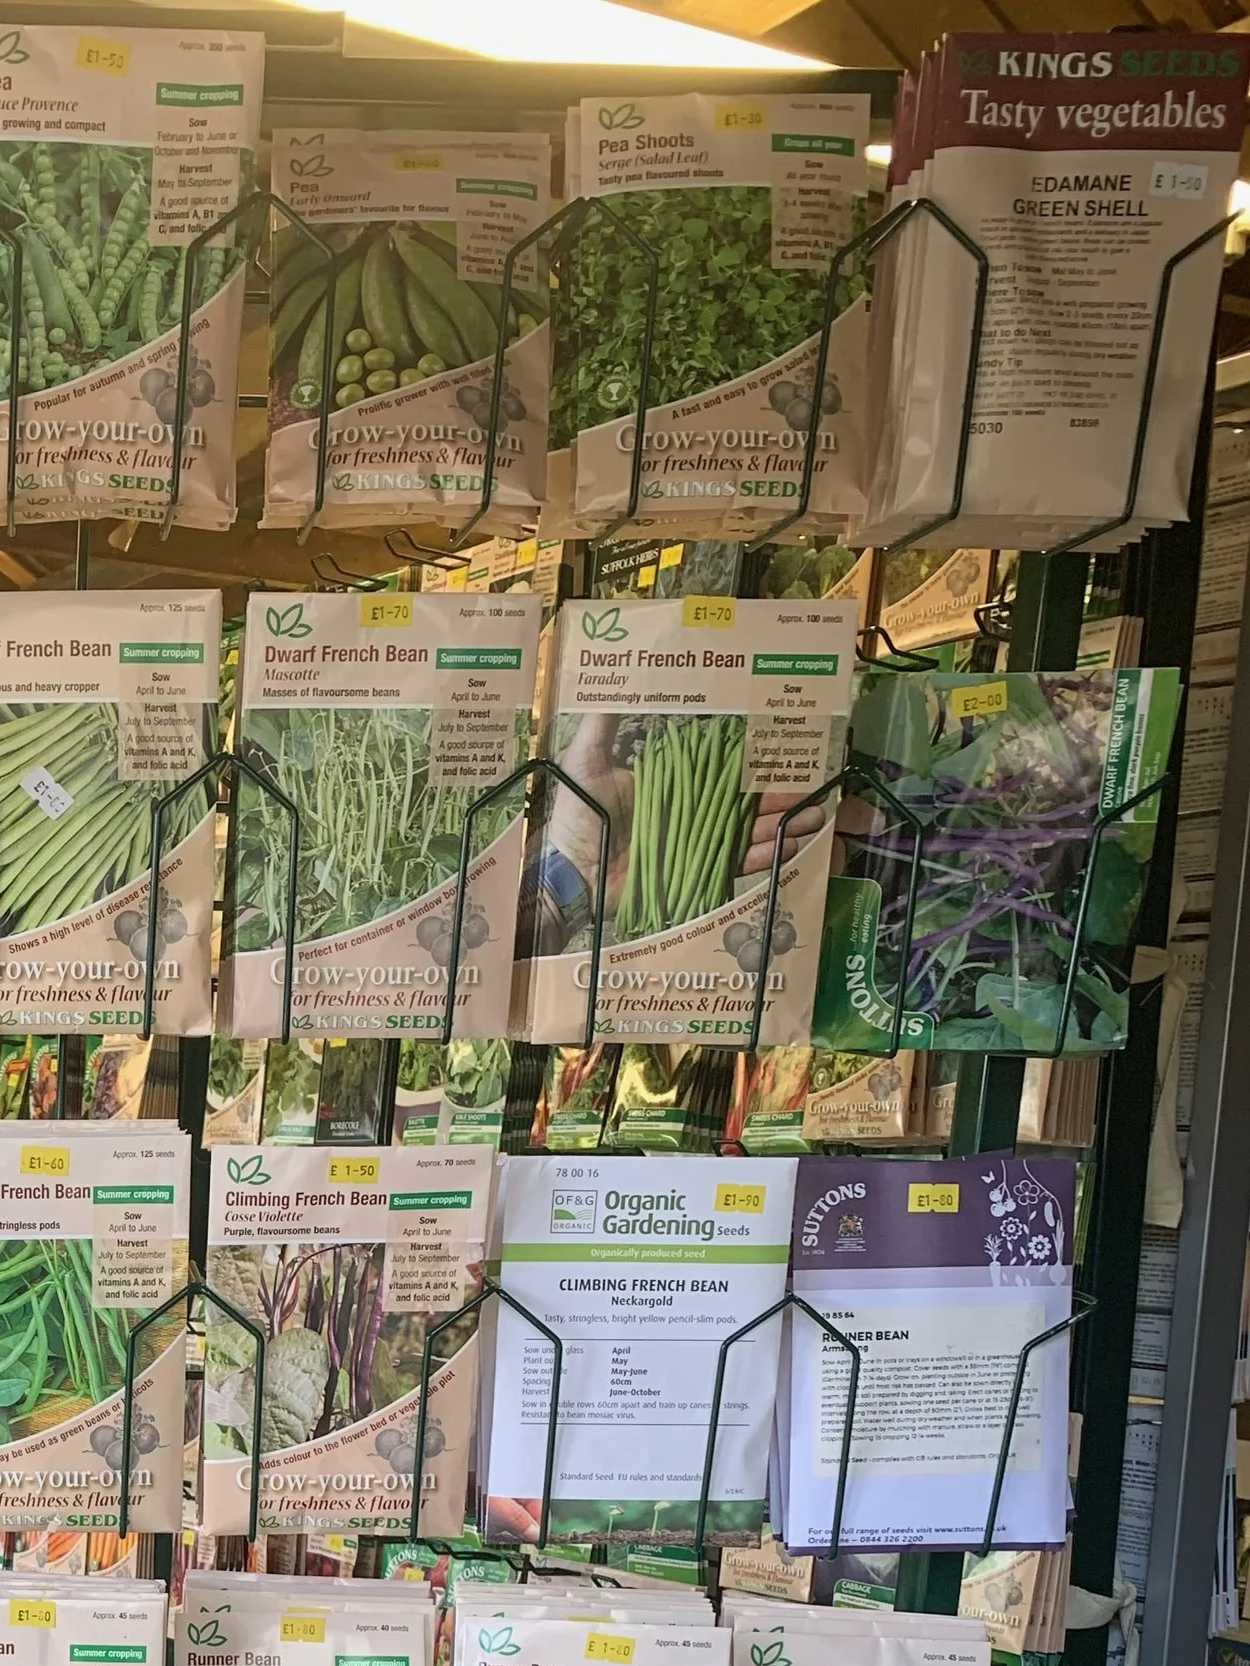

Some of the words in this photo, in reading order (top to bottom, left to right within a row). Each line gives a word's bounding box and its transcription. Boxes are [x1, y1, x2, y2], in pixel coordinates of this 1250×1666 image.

[86, 50, 125, 68] £1-50
[998, 52, 1112, 78] KINGS
[1119, 50, 1239, 77] SEEDS
[16, 97, 78, 112] Provence
[960, 90, 1046, 138] Tasty
[1055, 91, 1226, 137] vegetables
[599, 137, 629, 154] Pea
[635, 134, 694, 151] Shoots
[1032, 175, 1131, 193] EDAMANE
[1013, 198, 1081, 217] GREEN
[1085, 200, 1148, 217] SHELL
[371, 605, 409, 620] £1-70
[694, 606, 732, 621] £1-70
[7, 640, 63, 659] French
[68, 639, 111, 658] Bean
[124, 648, 158, 660] Summer
[161, 647, 199, 661] cropping
[264, 668, 319, 682] Mascotte
[578, 672, 628, 688] Faraday
[15, 683, 33, 693] and
[36, 682, 62, 695] heavy
[65, 682, 100, 694] cropper
[964, 693, 1002, 711] £2-00
[29, 1156, 64, 1172] £1-60
[1, 1183, 50, 1200] French
[55, 1183, 90, 1199] Bean
[604, 1189, 686, 1214] Organic
[724, 1193, 760, 1208] £1-90
[917, 1194, 953, 1207] £1-80
[225, 1211, 253, 1222] Cosse
[256, 1210, 302, 1222] Violette
[802, 1182, 866, 1246] SUTTONS
[603, 1214, 714, 1241] Gardening
[717, 1225, 750, 1236] Seeds
[591, 1249, 638, 1260] Organically
[641, 1249, 681, 1259] produced
[685, 1248, 705, 1258] seed
[559, 1278, 626, 1293] CLIMBING
[632, 1279, 686, 1293] FRENCH
[691, 1280, 729, 1293] BEAN
[611, 1295, 673, 1308] Neckargold
[611, 1357, 628, 1366] May
[610, 1377, 632, 1387] 60cm
